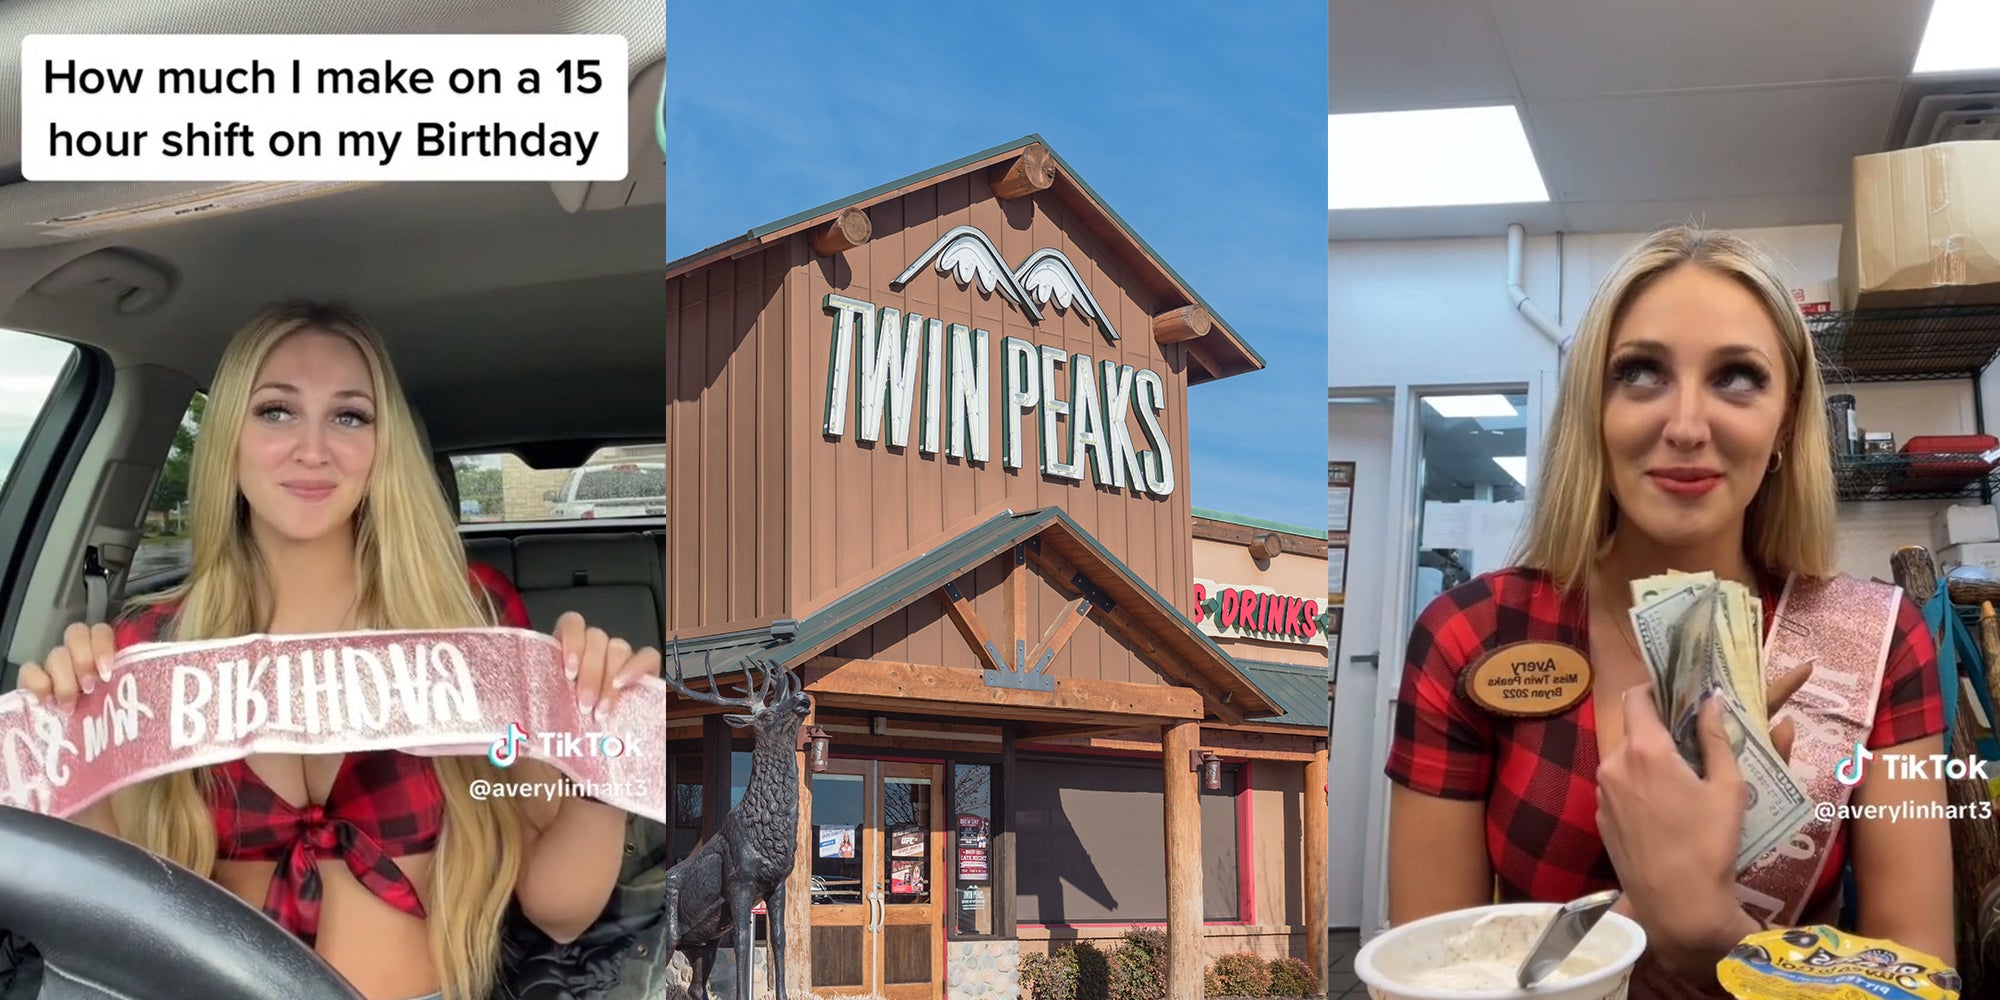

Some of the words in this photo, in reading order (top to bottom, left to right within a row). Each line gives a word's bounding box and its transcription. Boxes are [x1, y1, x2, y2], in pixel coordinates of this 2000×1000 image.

[822, 293, 990, 463] TWIN
[1002, 336, 1175, 497] PEAKS
[1220, 587, 1319, 638] DRINKS
[901, 837, 914, 845] UFC
